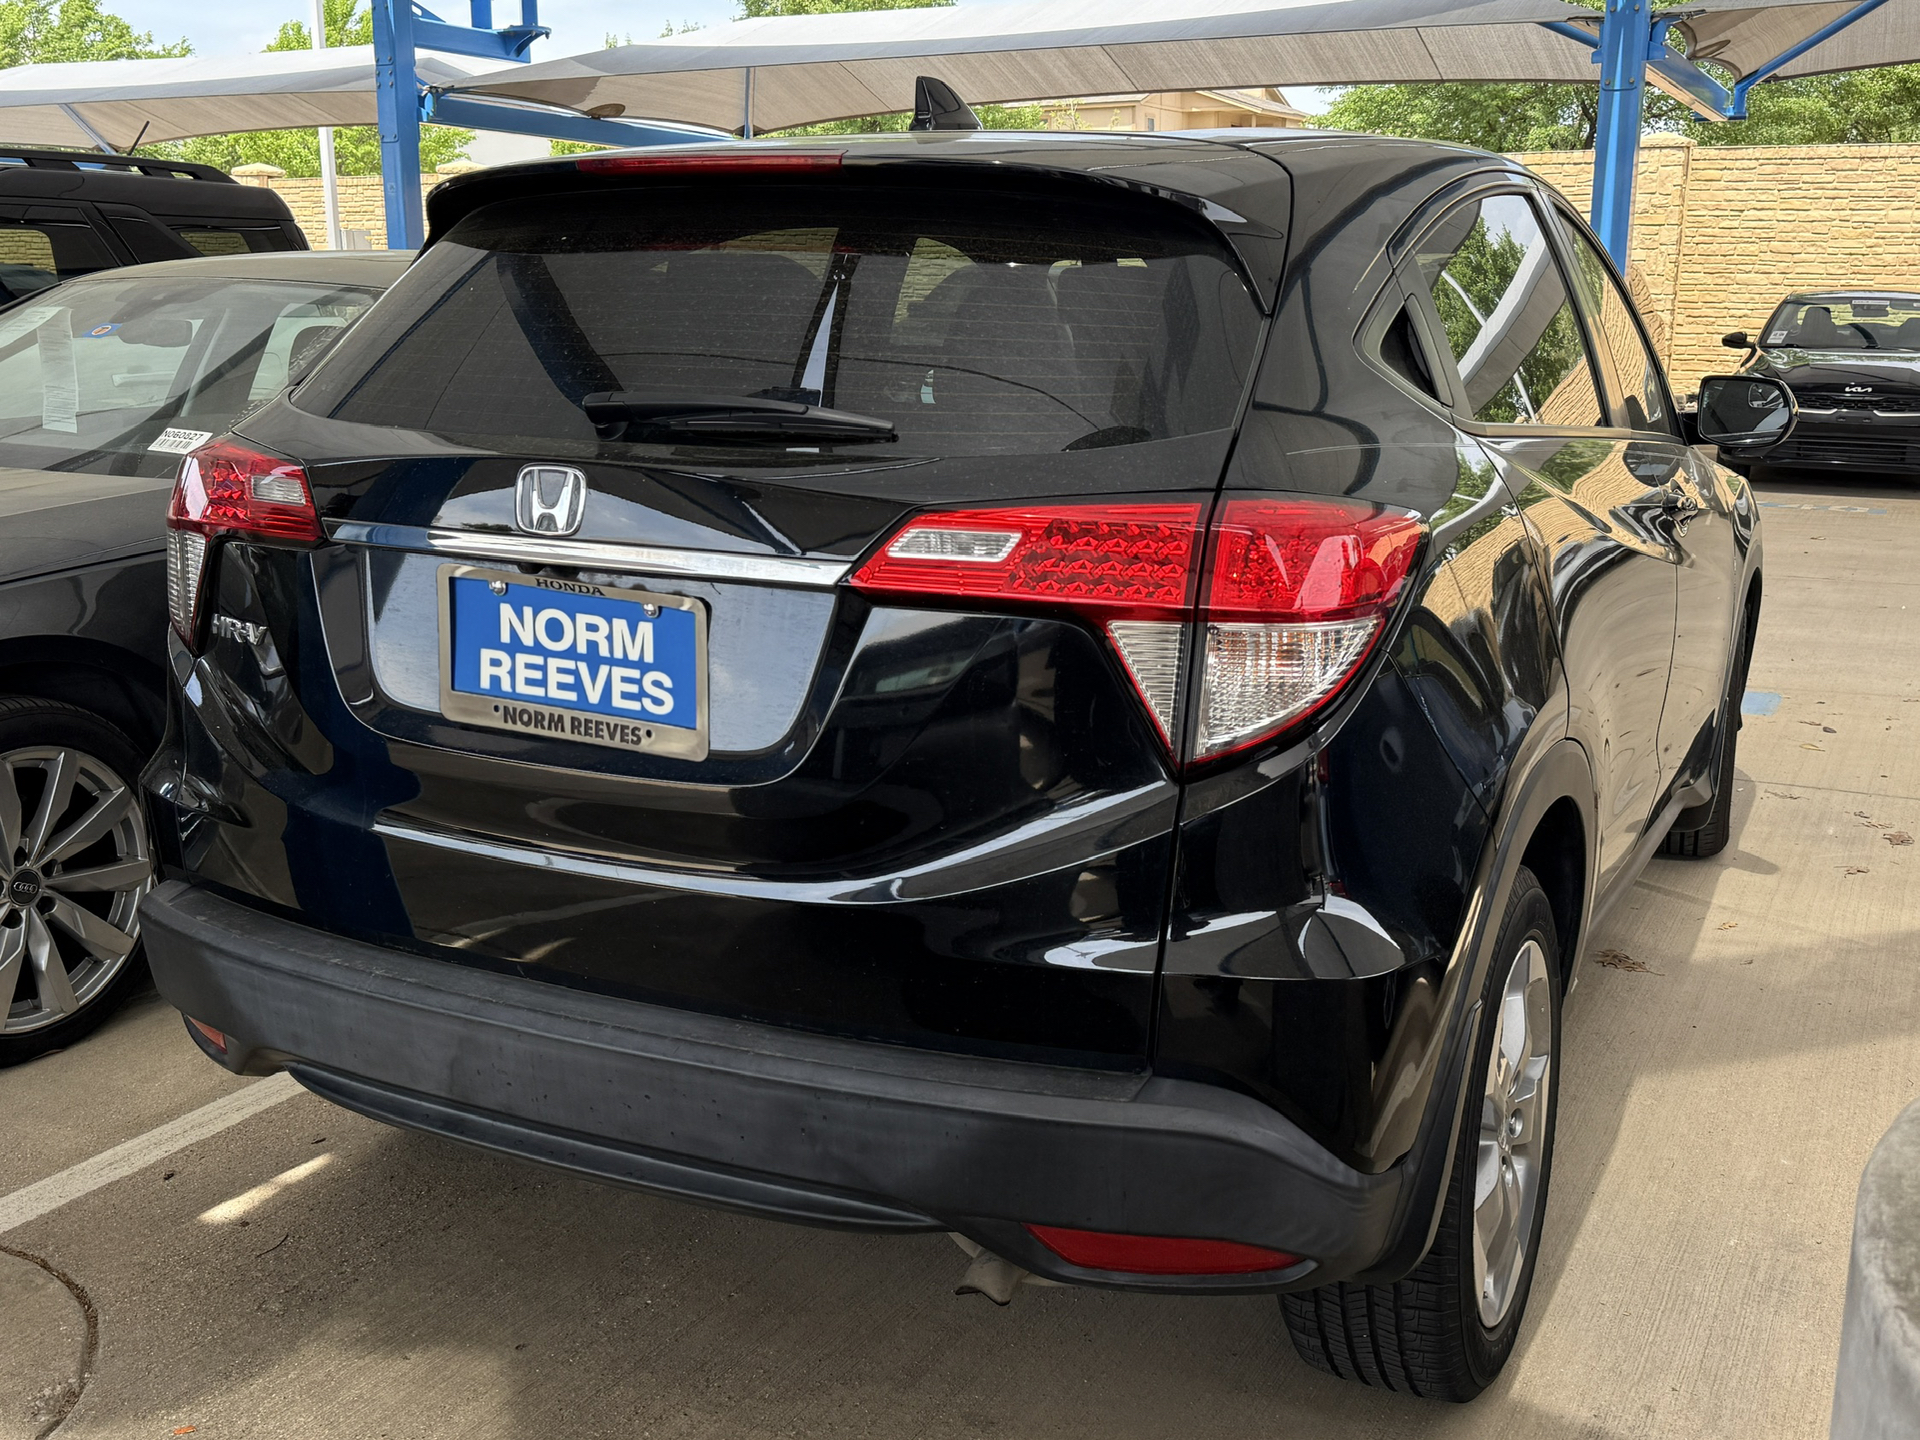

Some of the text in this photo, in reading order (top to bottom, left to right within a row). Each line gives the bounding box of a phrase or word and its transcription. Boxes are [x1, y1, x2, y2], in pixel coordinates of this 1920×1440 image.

[535, 578, 606, 596] HONDA
[500, 603, 654, 663] NORM
[480, 648, 674, 715] REEVES
[503, 706, 642, 745] NORM REEVES
